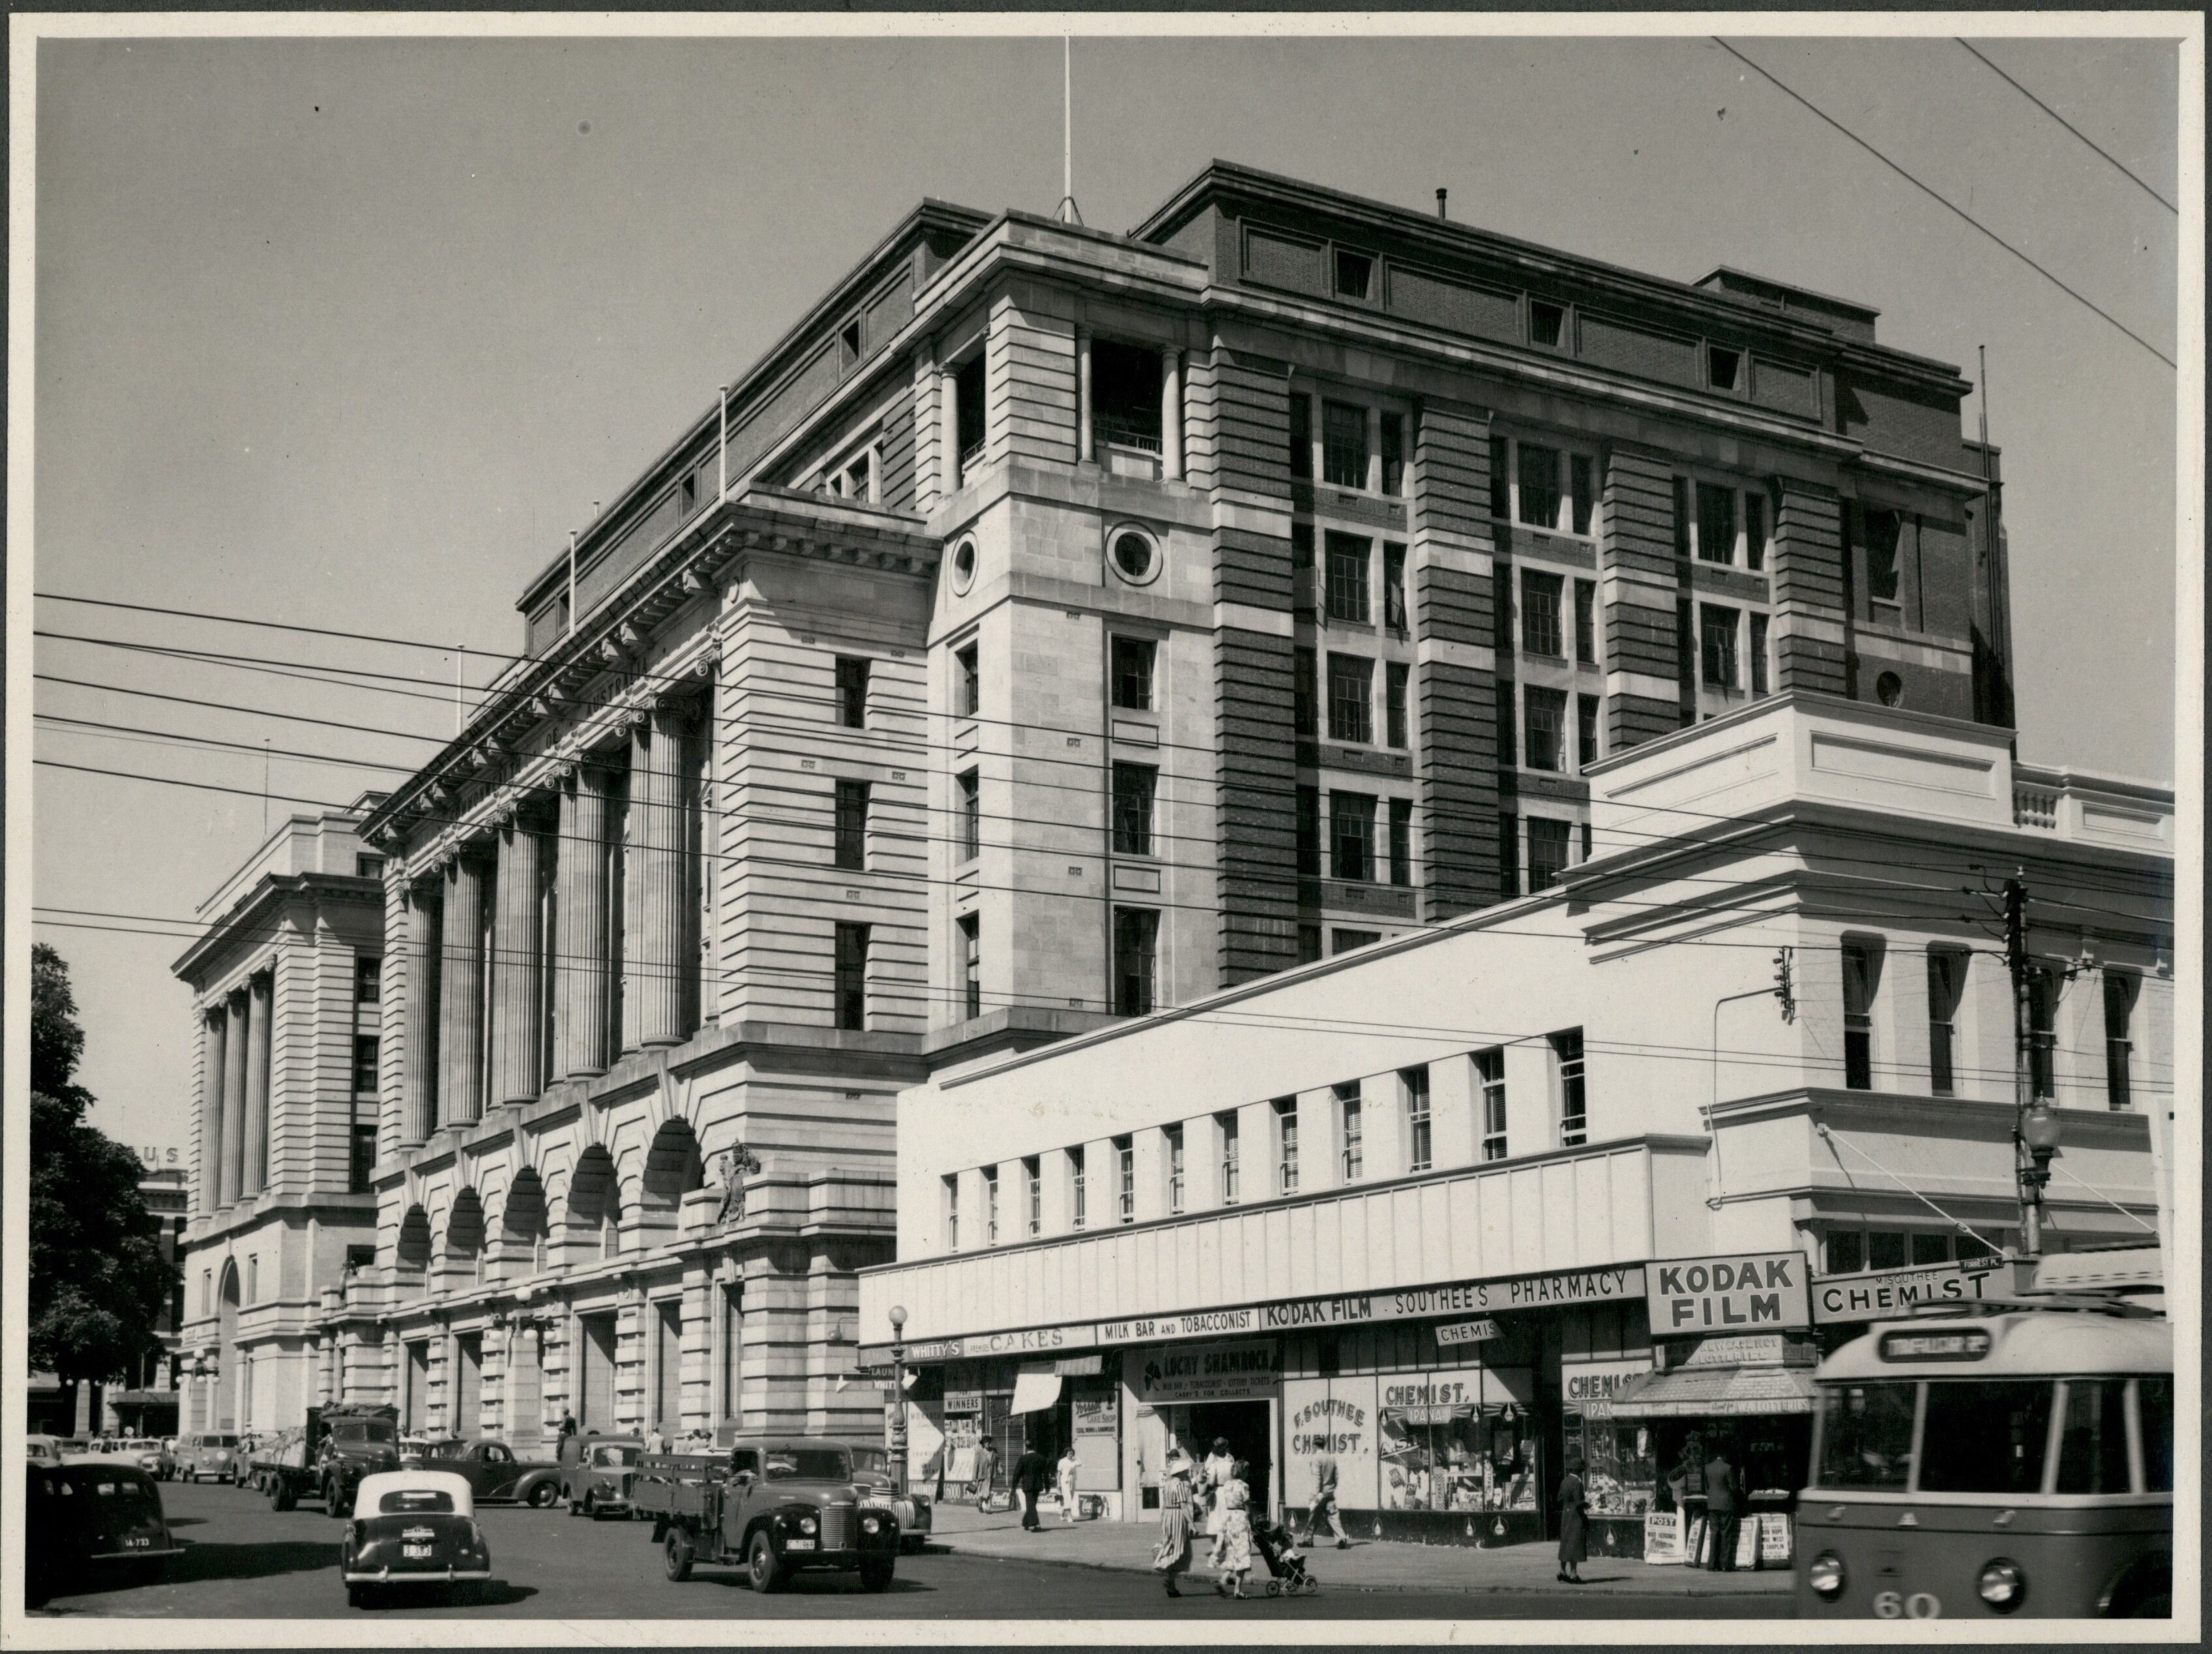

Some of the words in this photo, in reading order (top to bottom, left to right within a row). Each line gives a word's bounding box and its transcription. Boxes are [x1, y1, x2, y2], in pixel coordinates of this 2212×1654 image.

[1511, 1270, 1627, 1304] PHARMACY
[1659, 1260, 1793, 1295] KODAK
[1887, 1271, 1938, 1285] SOUTHEE
[1823, 1272, 1990, 1312] CHEMIST
[1267, 1302, 1326, 1326] KODAK
[1331, 1297, 1372, 1321] FILM
[1672, 1293, 1780, 1327] FILM
[1105, 1323, 1129, 1339] MILK
[1136, 1321, 1155, 1337] BAR
[1161, 1323, 1175, 1335] AND
[1181, 1311, 1250, 1333] TOBACCONIST
[911, 1341, 960, 1359] WHITTY'S
[990, 1329, 1063, 1351] CAKES
[871, 1367, 894, 1376] LAUN
[947, 1398, 979, 1410] WINNERS
[1304, 1399, 1366, 1428] SOUTHEE
[1409, 1408, 1442, 1422] IPANA
[1586, 1402, 1612, 1417] IPAN
[1651, 1517, 1675, 1526] POST
[1874, 1591, 1941, 1619] 60
